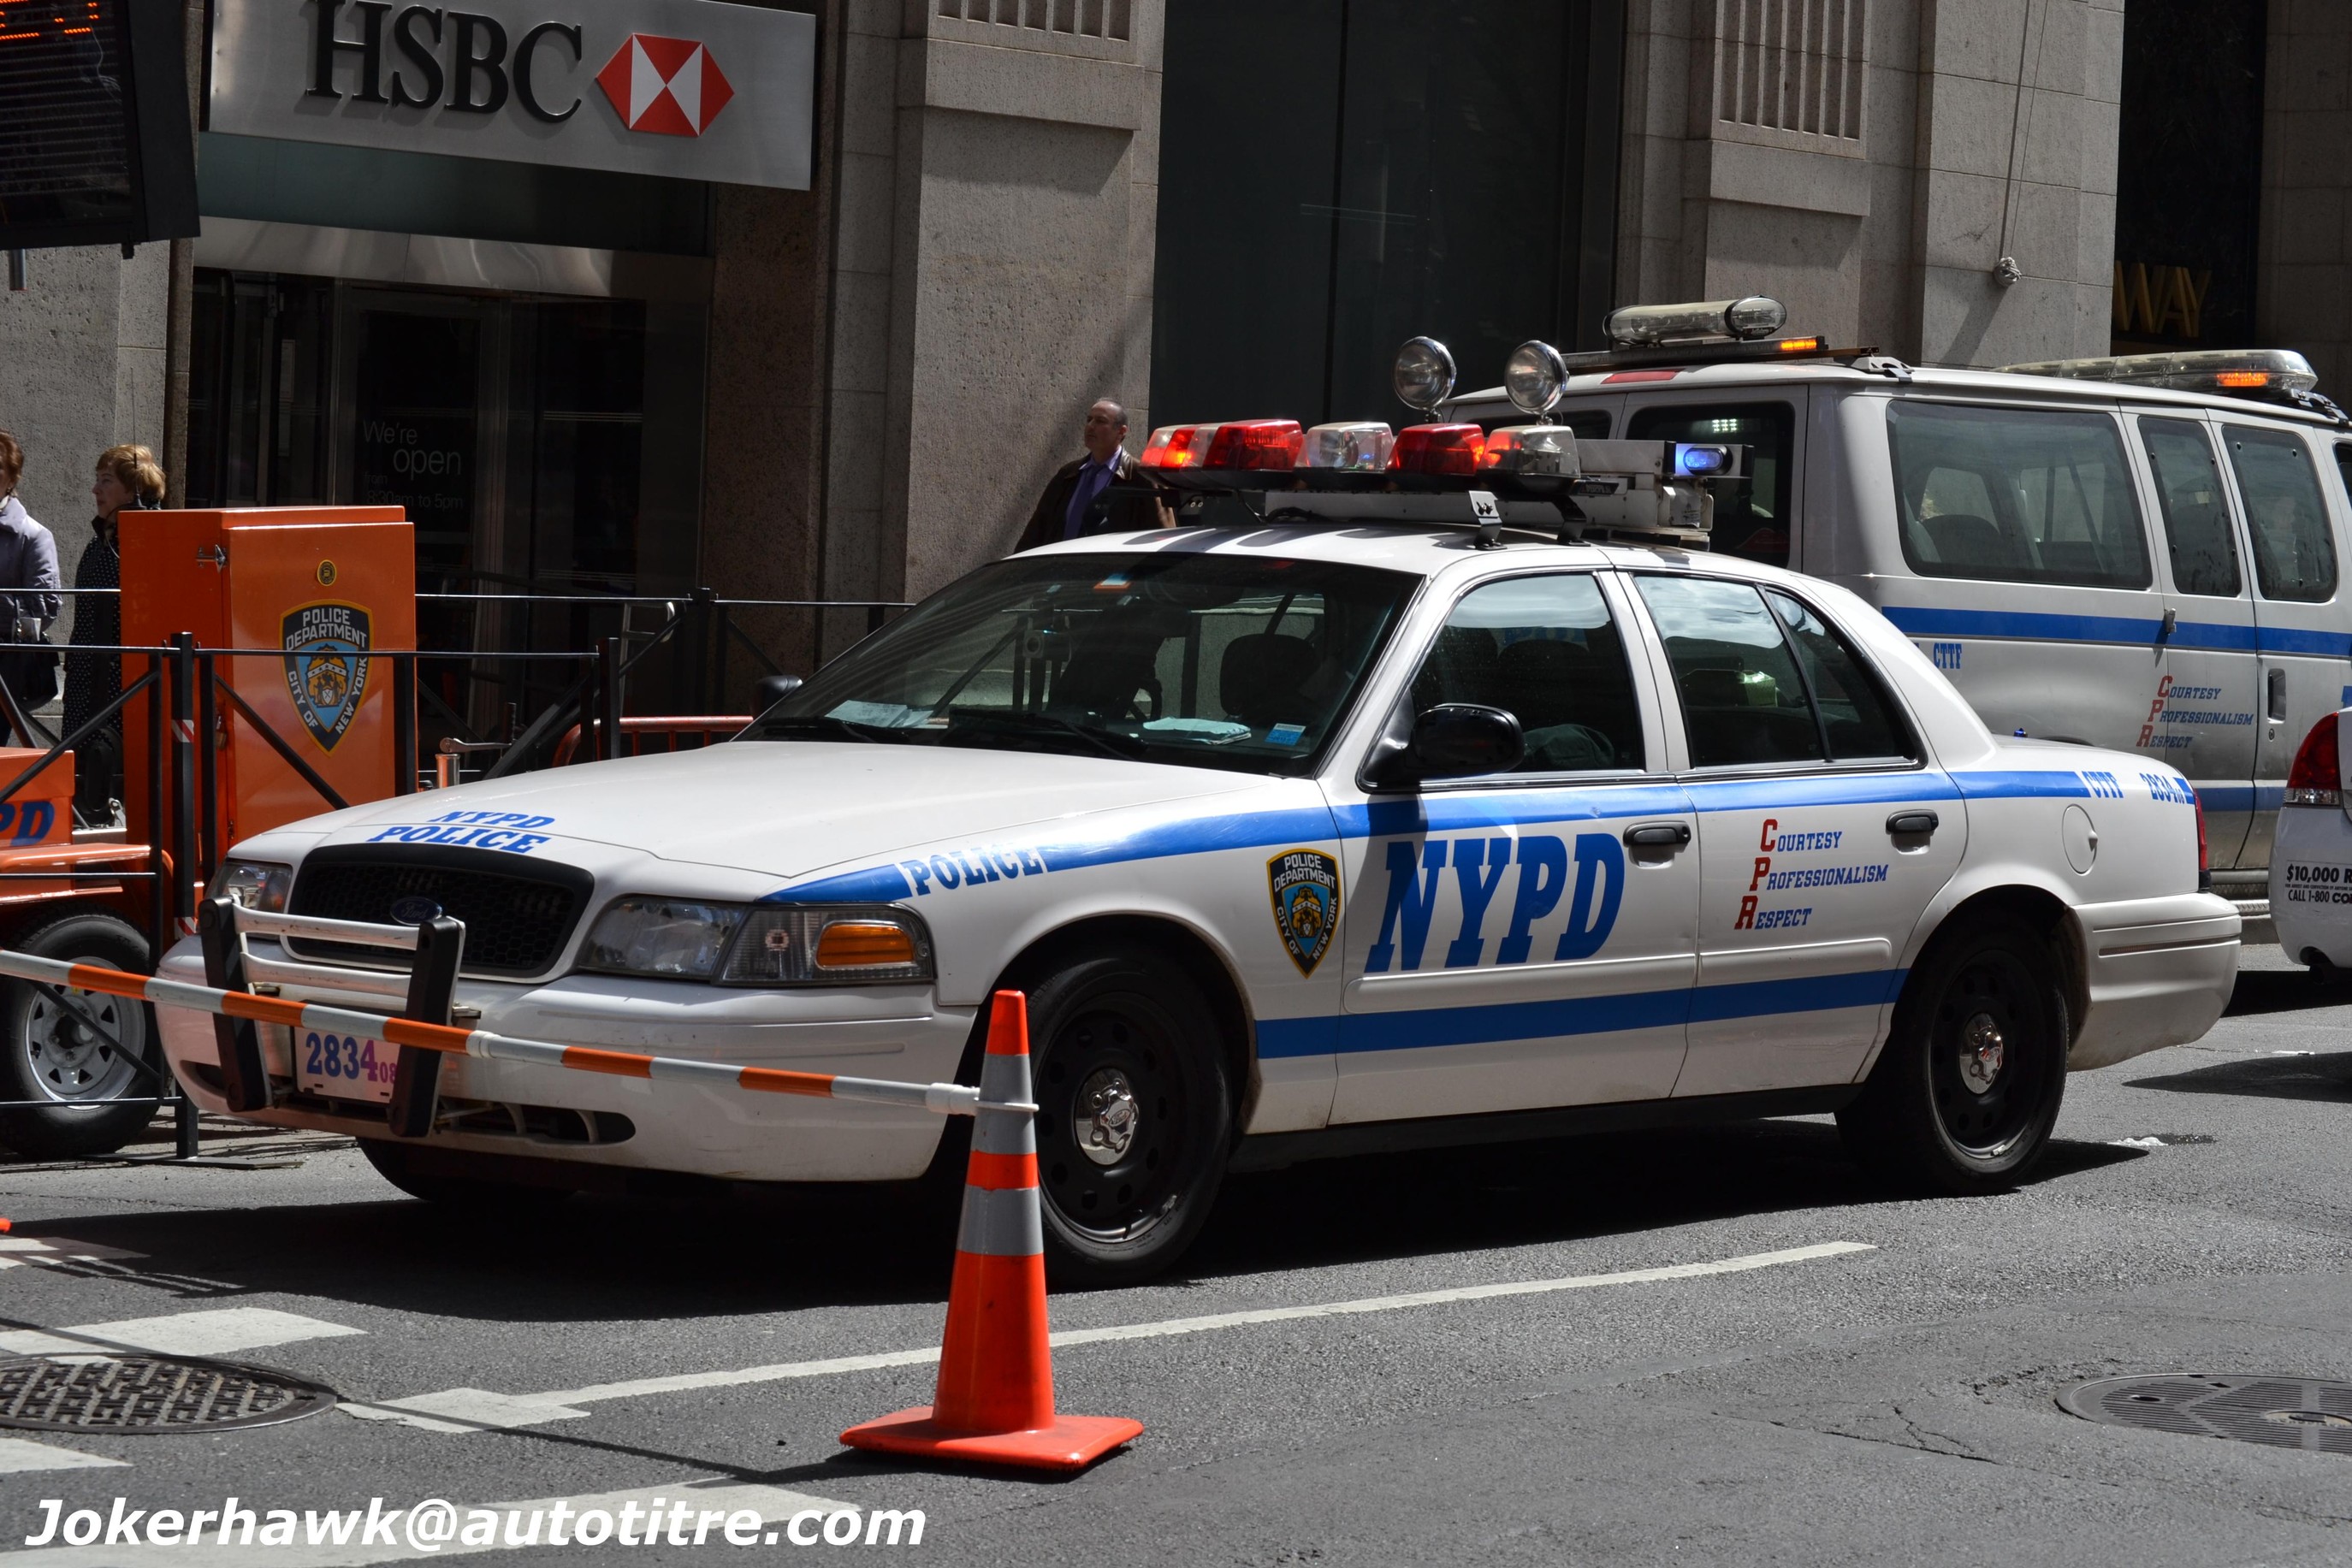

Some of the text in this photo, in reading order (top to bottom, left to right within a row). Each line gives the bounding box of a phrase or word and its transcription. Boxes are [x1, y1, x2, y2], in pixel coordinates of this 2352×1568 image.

[305, 0, 582, 123] HSBC
[2112, 260, 2212, 337] WAY
[363, 418, 418, 445] We're
[394, 448, 461, 481] open
[418, 494, 431, 507] to
[435, 493, 463, 511] 5pm
[303, 607, 351, 627] POLICE
[286, 624, 367, 651] DEPARTMENT
[1934, 642, 1963, 669] CTTF
[288, 657, 368, 735] CITY OF NEW YORK
[426, 811, 555, 829] NYPD
[365, 825, 552, 854] POLICE
[900, 843, 1043, 896] POLICE
[1284, 854, 1322, 871] POLICE
[2286, 863, 2340, 883] $10,000
[1274, 868, 1336, 892] DEPARTMENT
[1364, 833, 1625, 973] NYPD
[2288, 890, 2306, 902] CALL
[2308, 890, 2330, 902] 1-800
[1277, 897, 1337, 960] CITY OF NEW YORK
[305, 1032, 378, 1082] 2834
